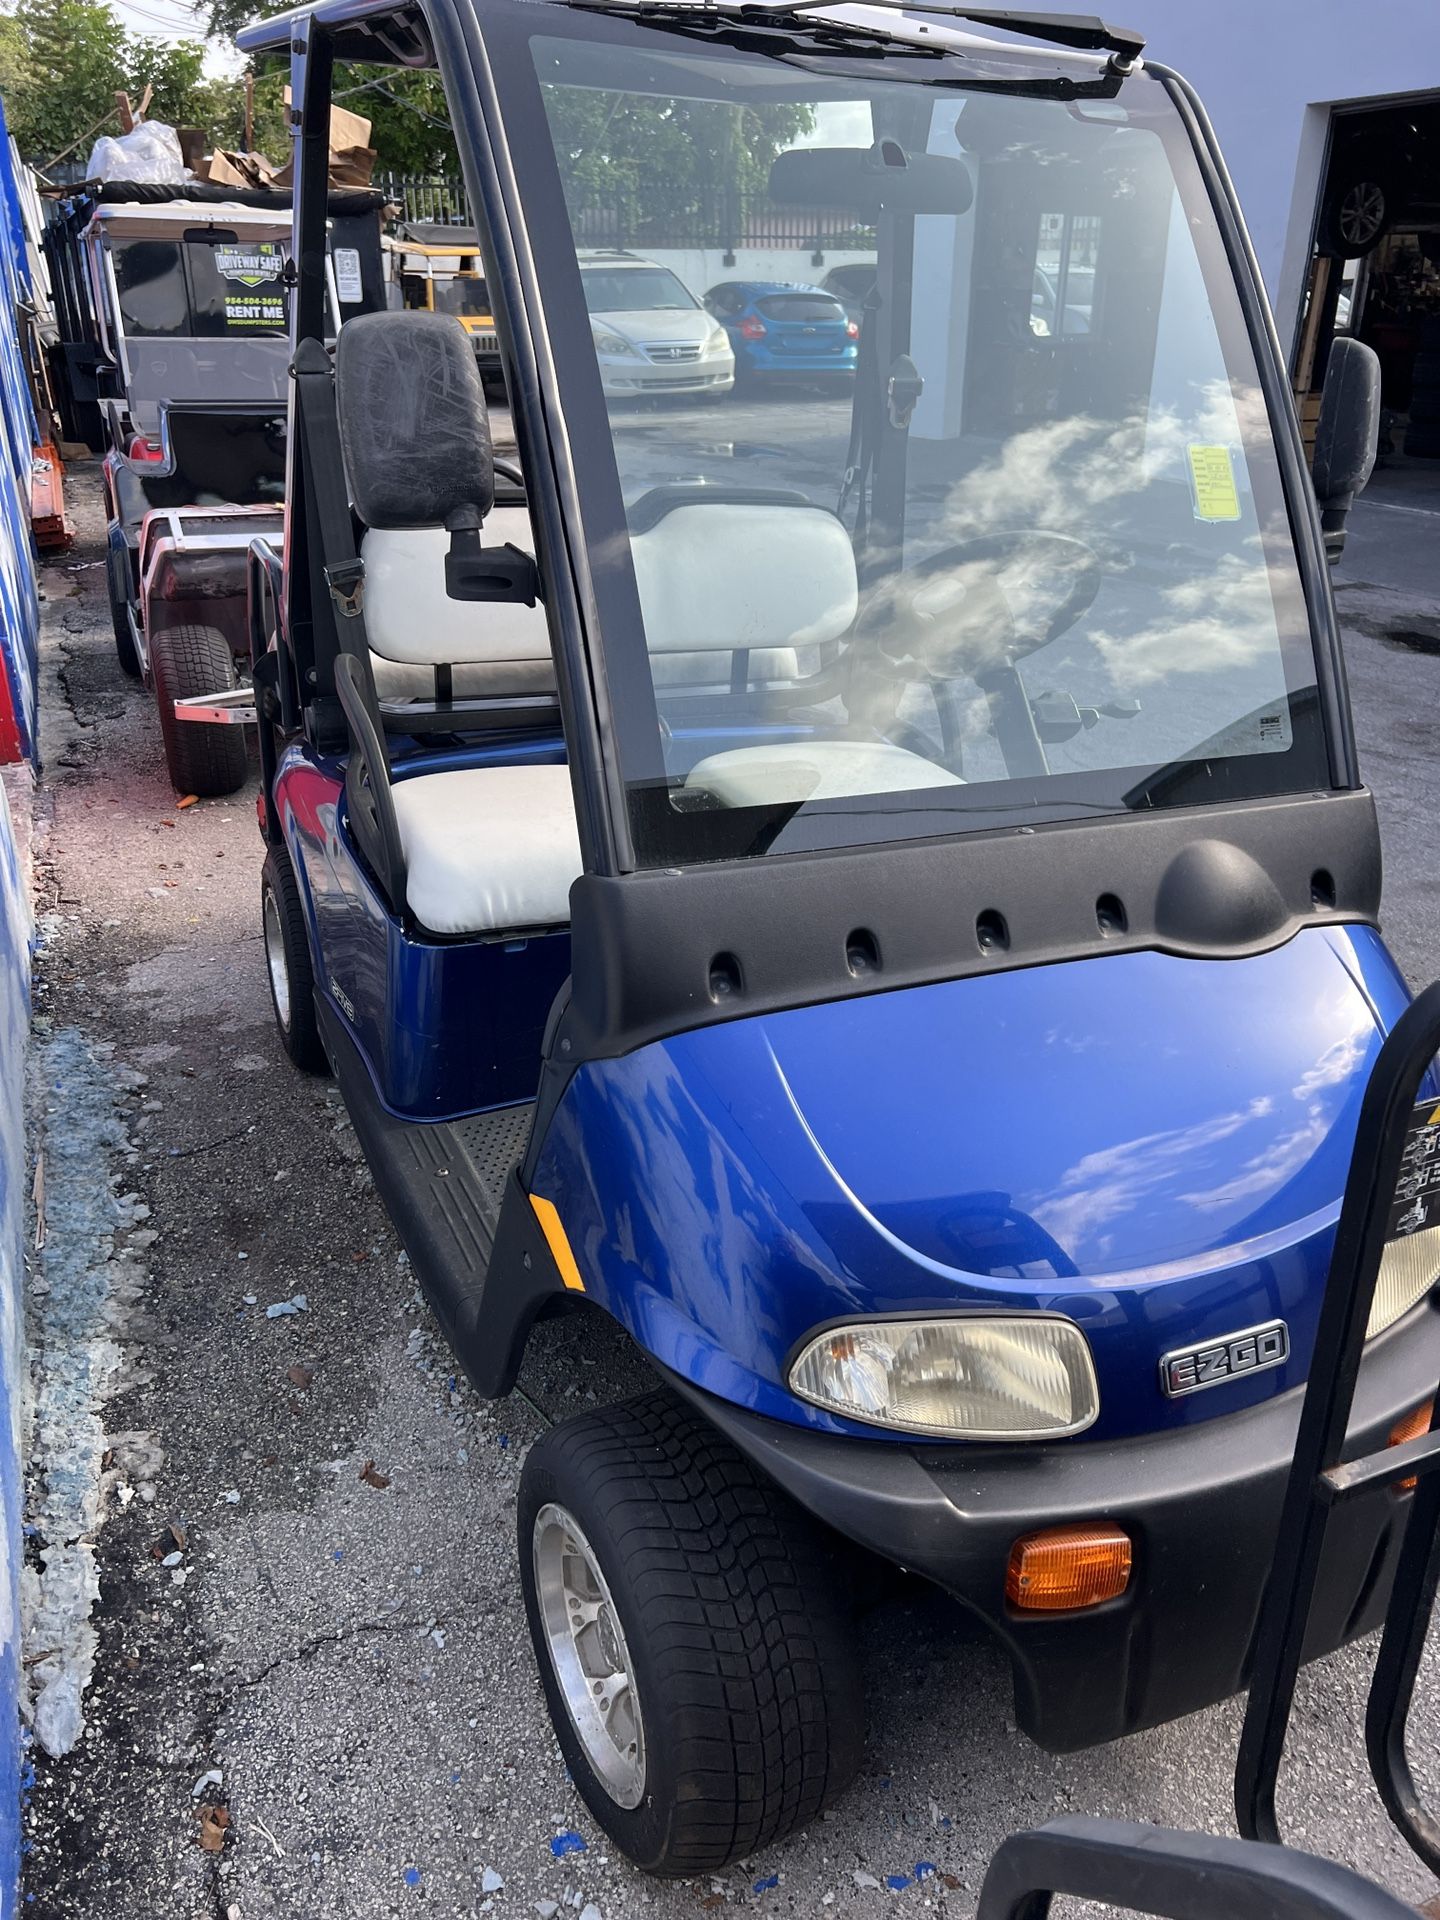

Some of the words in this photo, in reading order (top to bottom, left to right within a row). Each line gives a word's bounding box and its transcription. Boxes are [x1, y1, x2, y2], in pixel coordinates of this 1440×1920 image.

[218, 255, 260, 270] DRIVEWAY
[260, 255, 281, 271] SAFE
[225, 297, 283, 305] 954-504-3696
[226, 306, 261, 318] RENT
[262, 306, 284, 319] ME
[1169, 1329, 1282, 1390] EZGO
